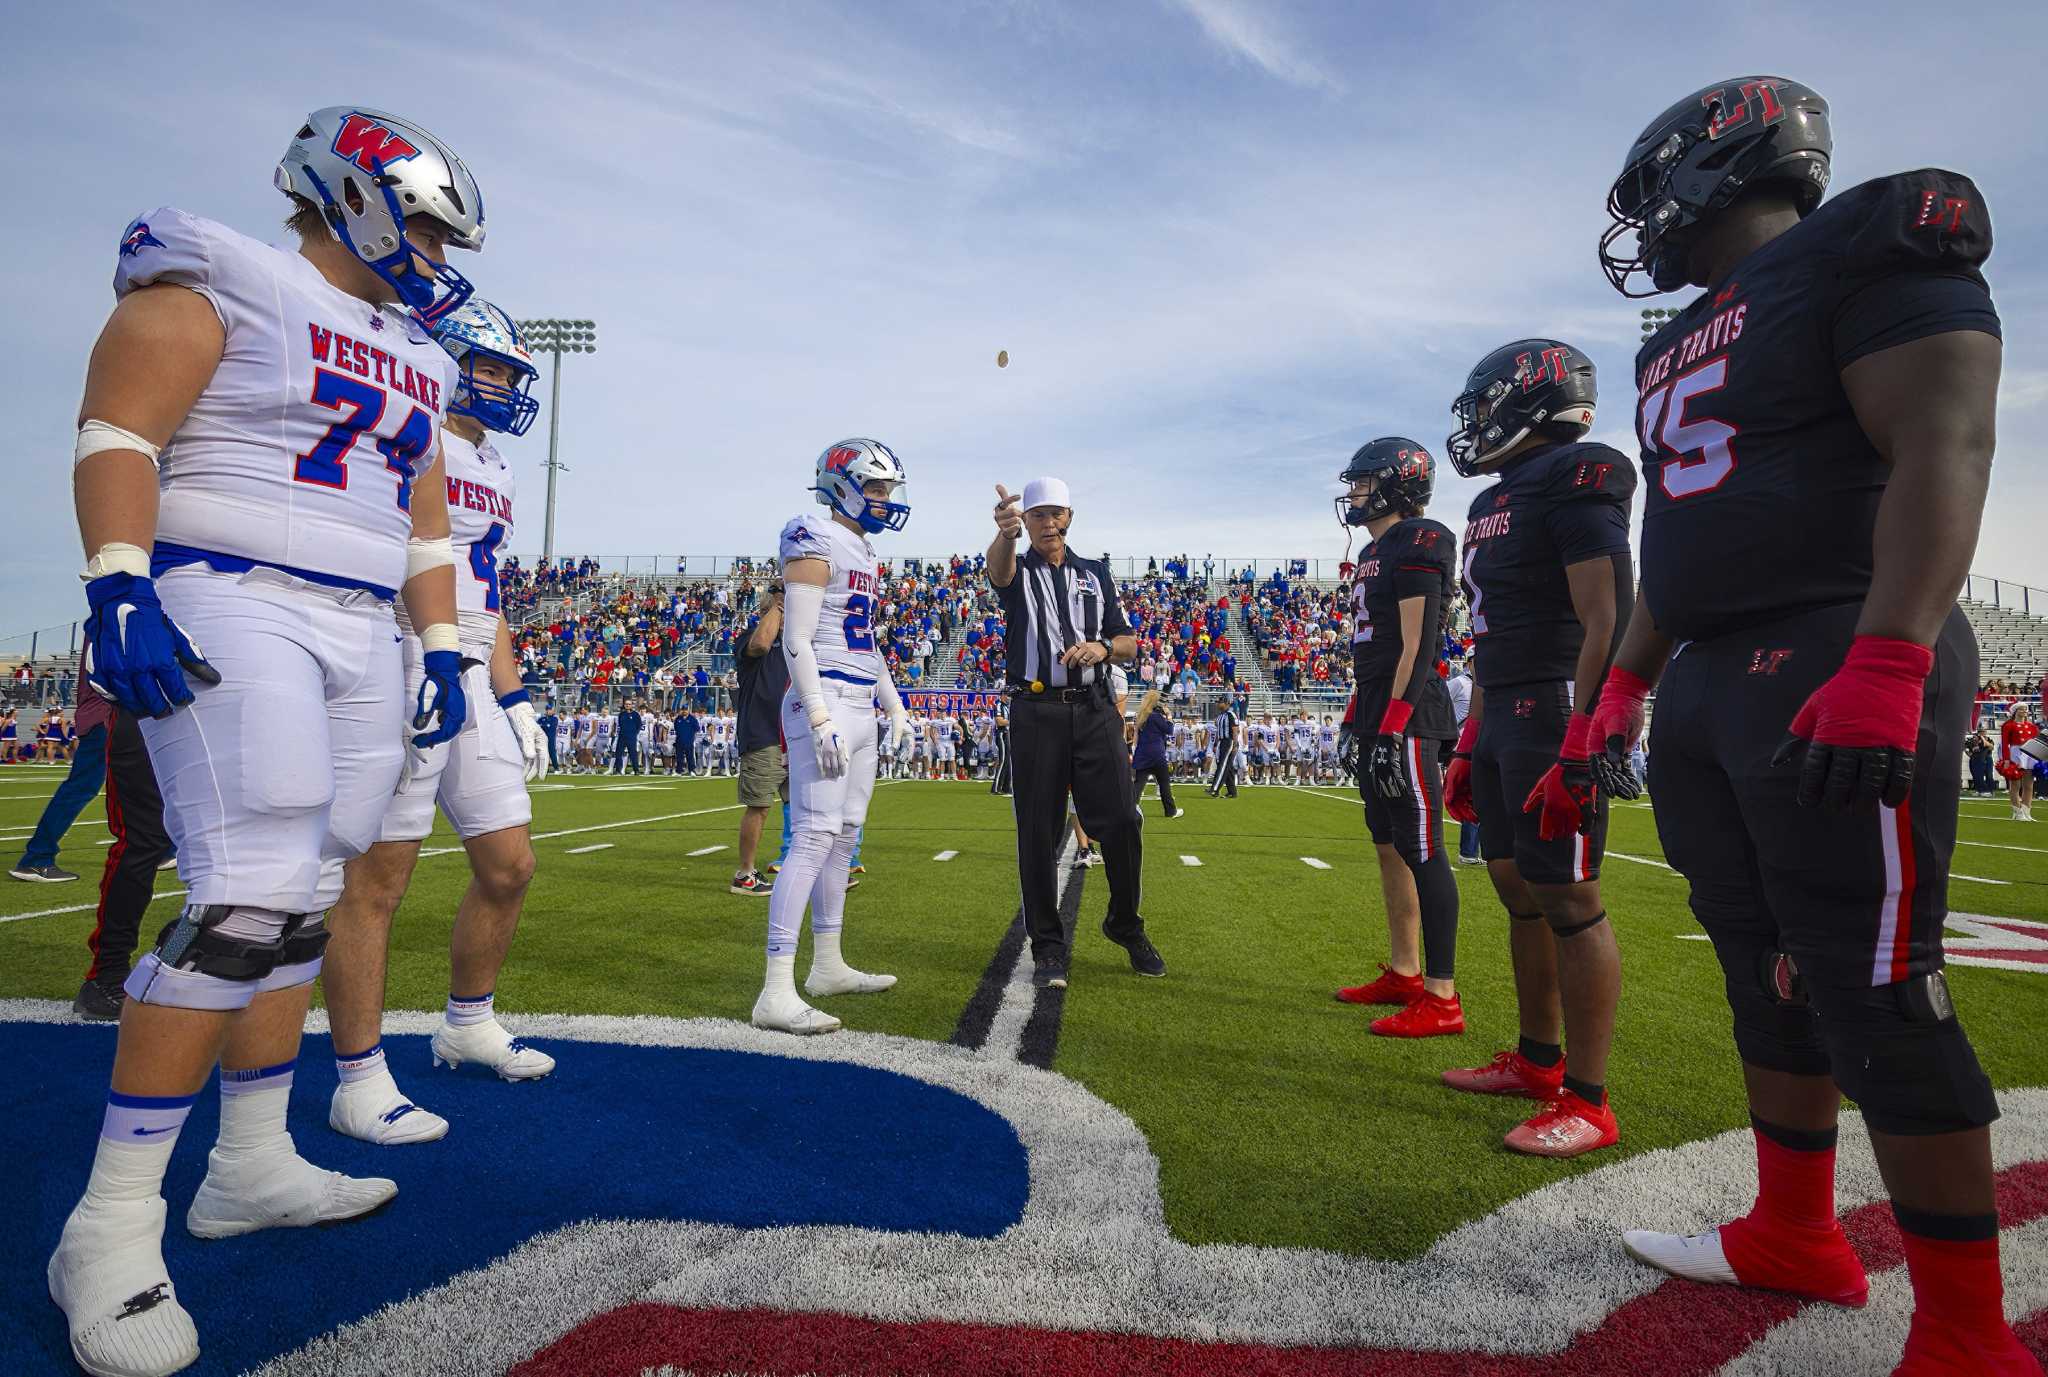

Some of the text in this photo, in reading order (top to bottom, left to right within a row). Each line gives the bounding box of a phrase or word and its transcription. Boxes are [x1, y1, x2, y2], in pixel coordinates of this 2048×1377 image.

[1701, 79, 1788, 141] LT
[331, 110, 423, 177] W
[1912, 190, 1970, 233] LT
[1677, 303, 1748, 370] TRAVIS
[308, 321, 441, 416] WESTLAKE
[1514, 347, 1573, 394] LT
[293, 366, 434, 520] 74
[825, 446, 862, 477] W
[1398, 449, 1429, 481] LT
[1574, 462, 1614, 490] LT
[468, 521, 506, 614] 4
[907, 693, 1001, 709] WESTLAK
